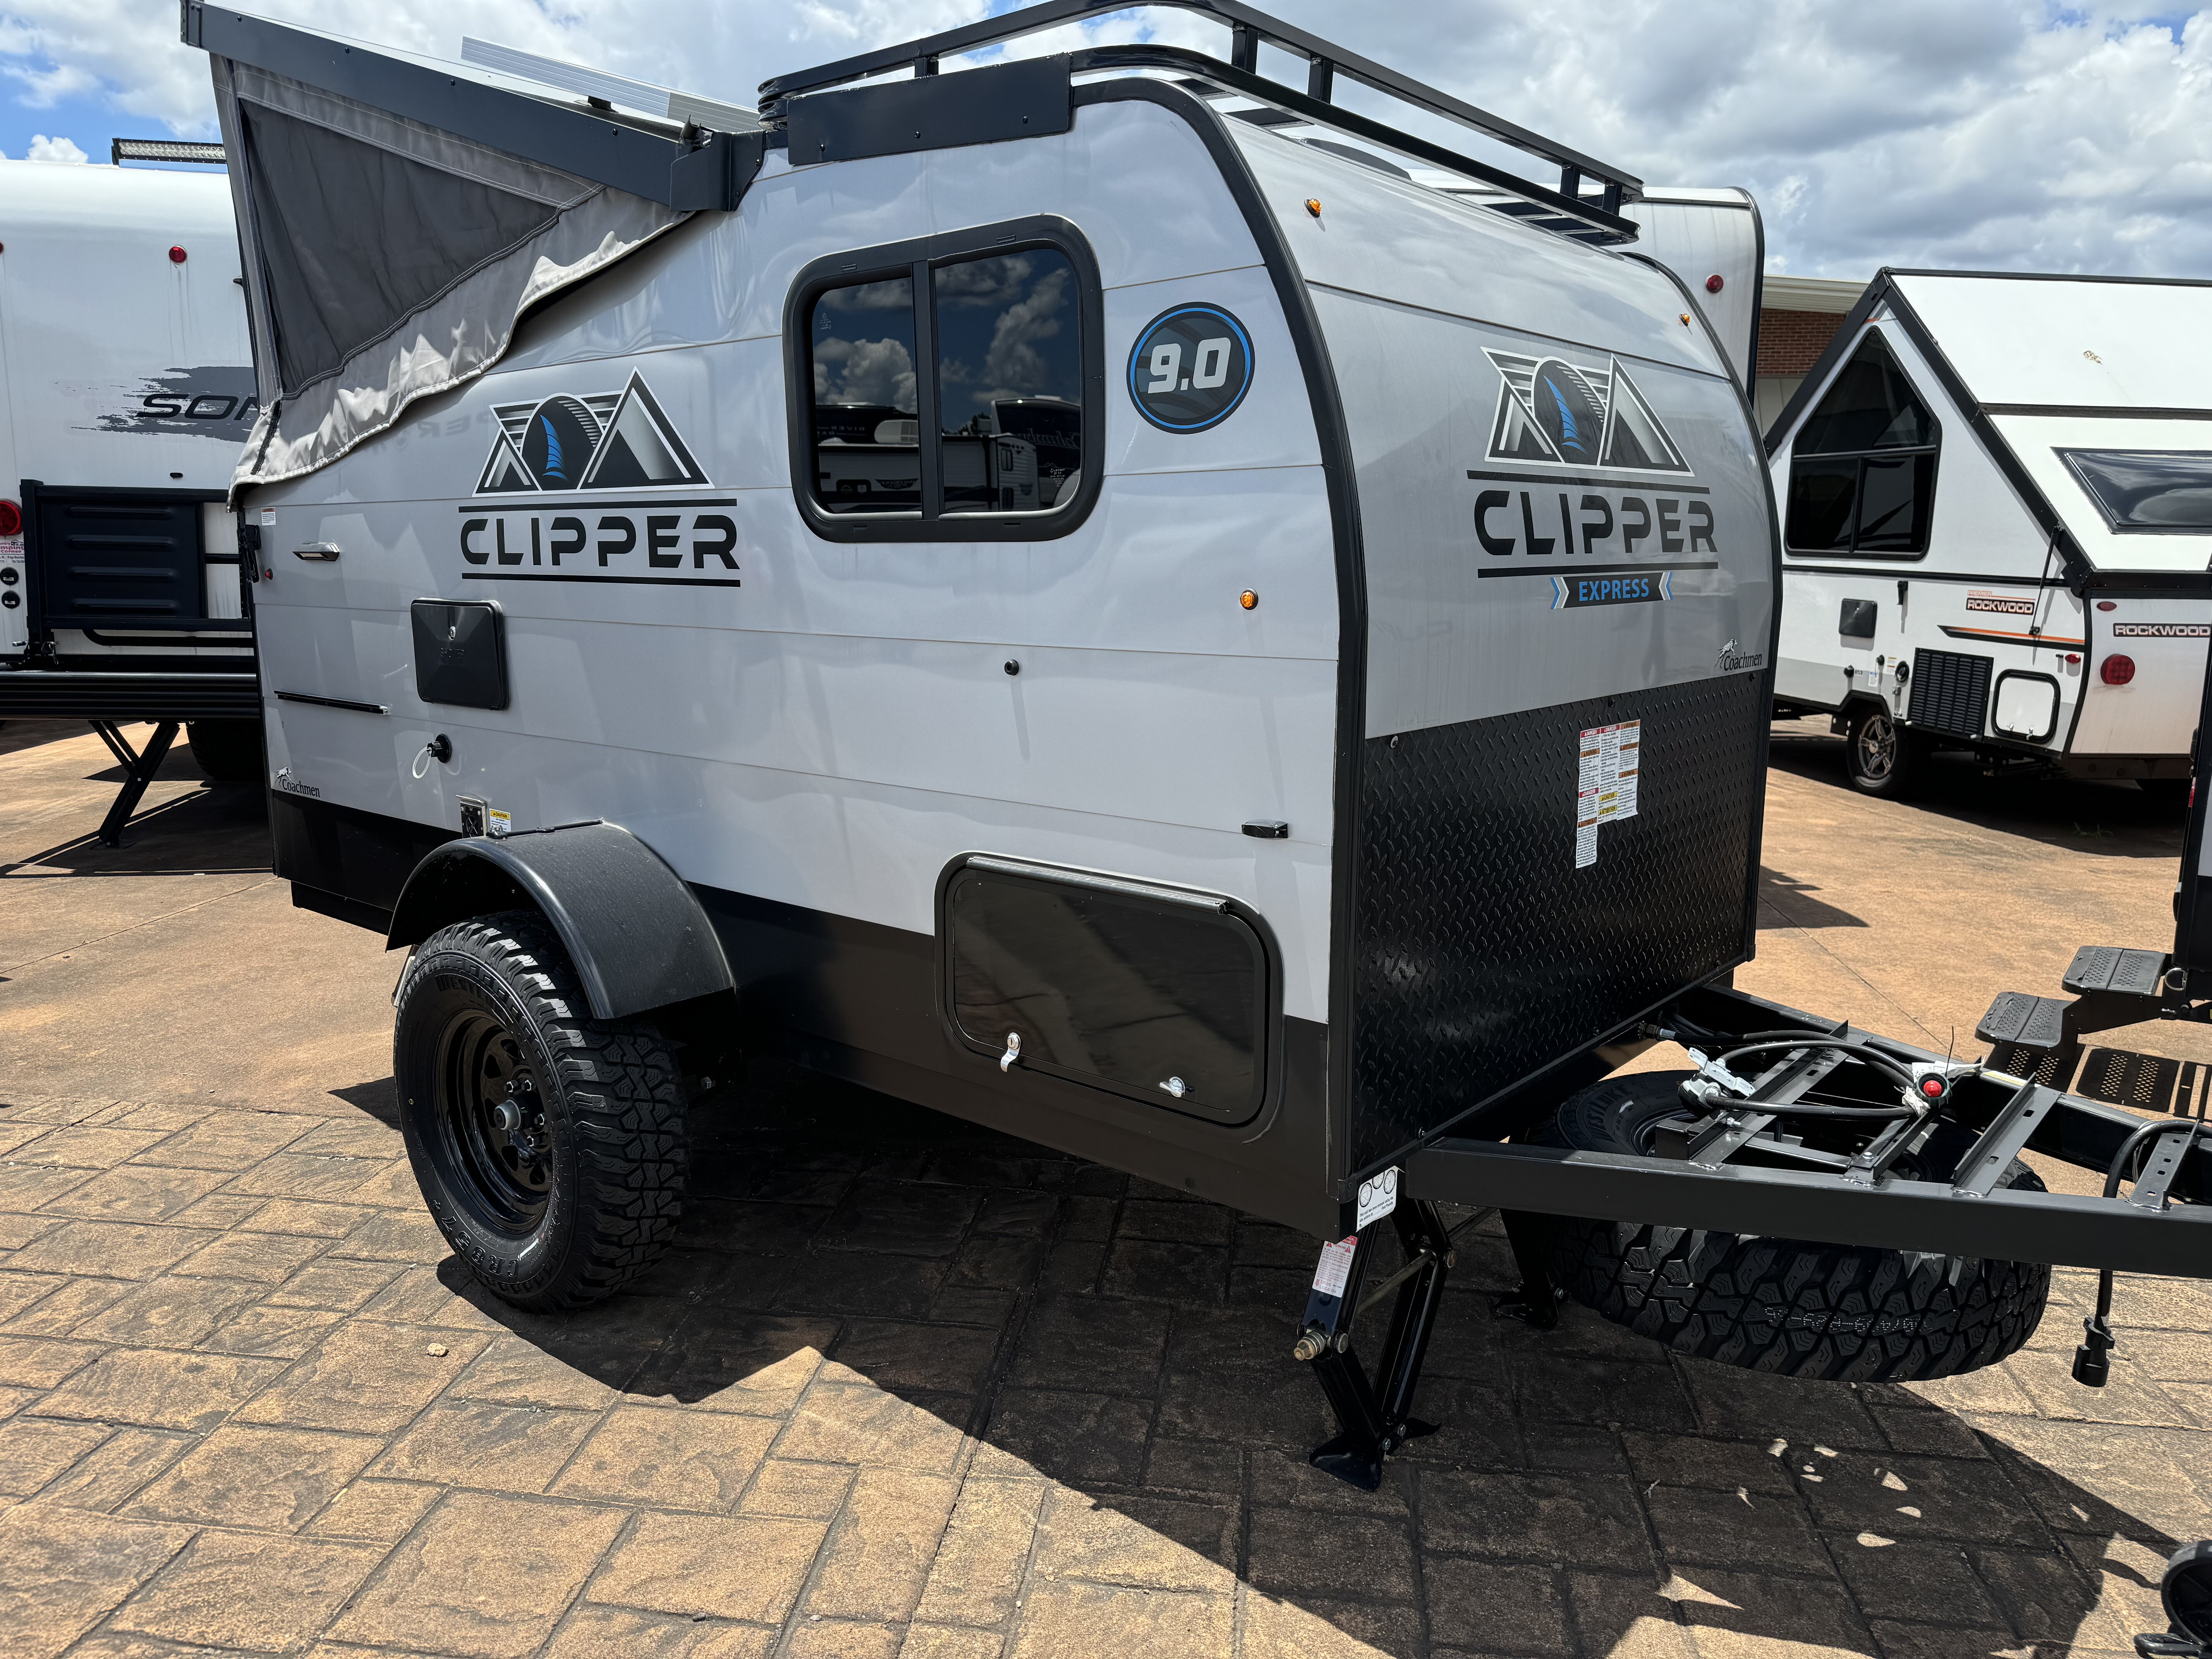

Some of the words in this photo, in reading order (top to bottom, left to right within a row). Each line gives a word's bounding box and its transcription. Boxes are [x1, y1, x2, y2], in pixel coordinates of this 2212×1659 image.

[1148, 337, 1231, 393] 9.0
[1474, 490, 1718, 556] CLIPPER
[460, 515, 740, 569] CLIPPER
[1579, 578, 1649, 602] EXPRESS
[1967, 599, 2033, 614] ROCKWOOD
[2115, 625, 2210, 636] ROCKWOOD
[1724, 652, 1762, 671] Coachmen
[282, 778, 321, 798] Coachmen
